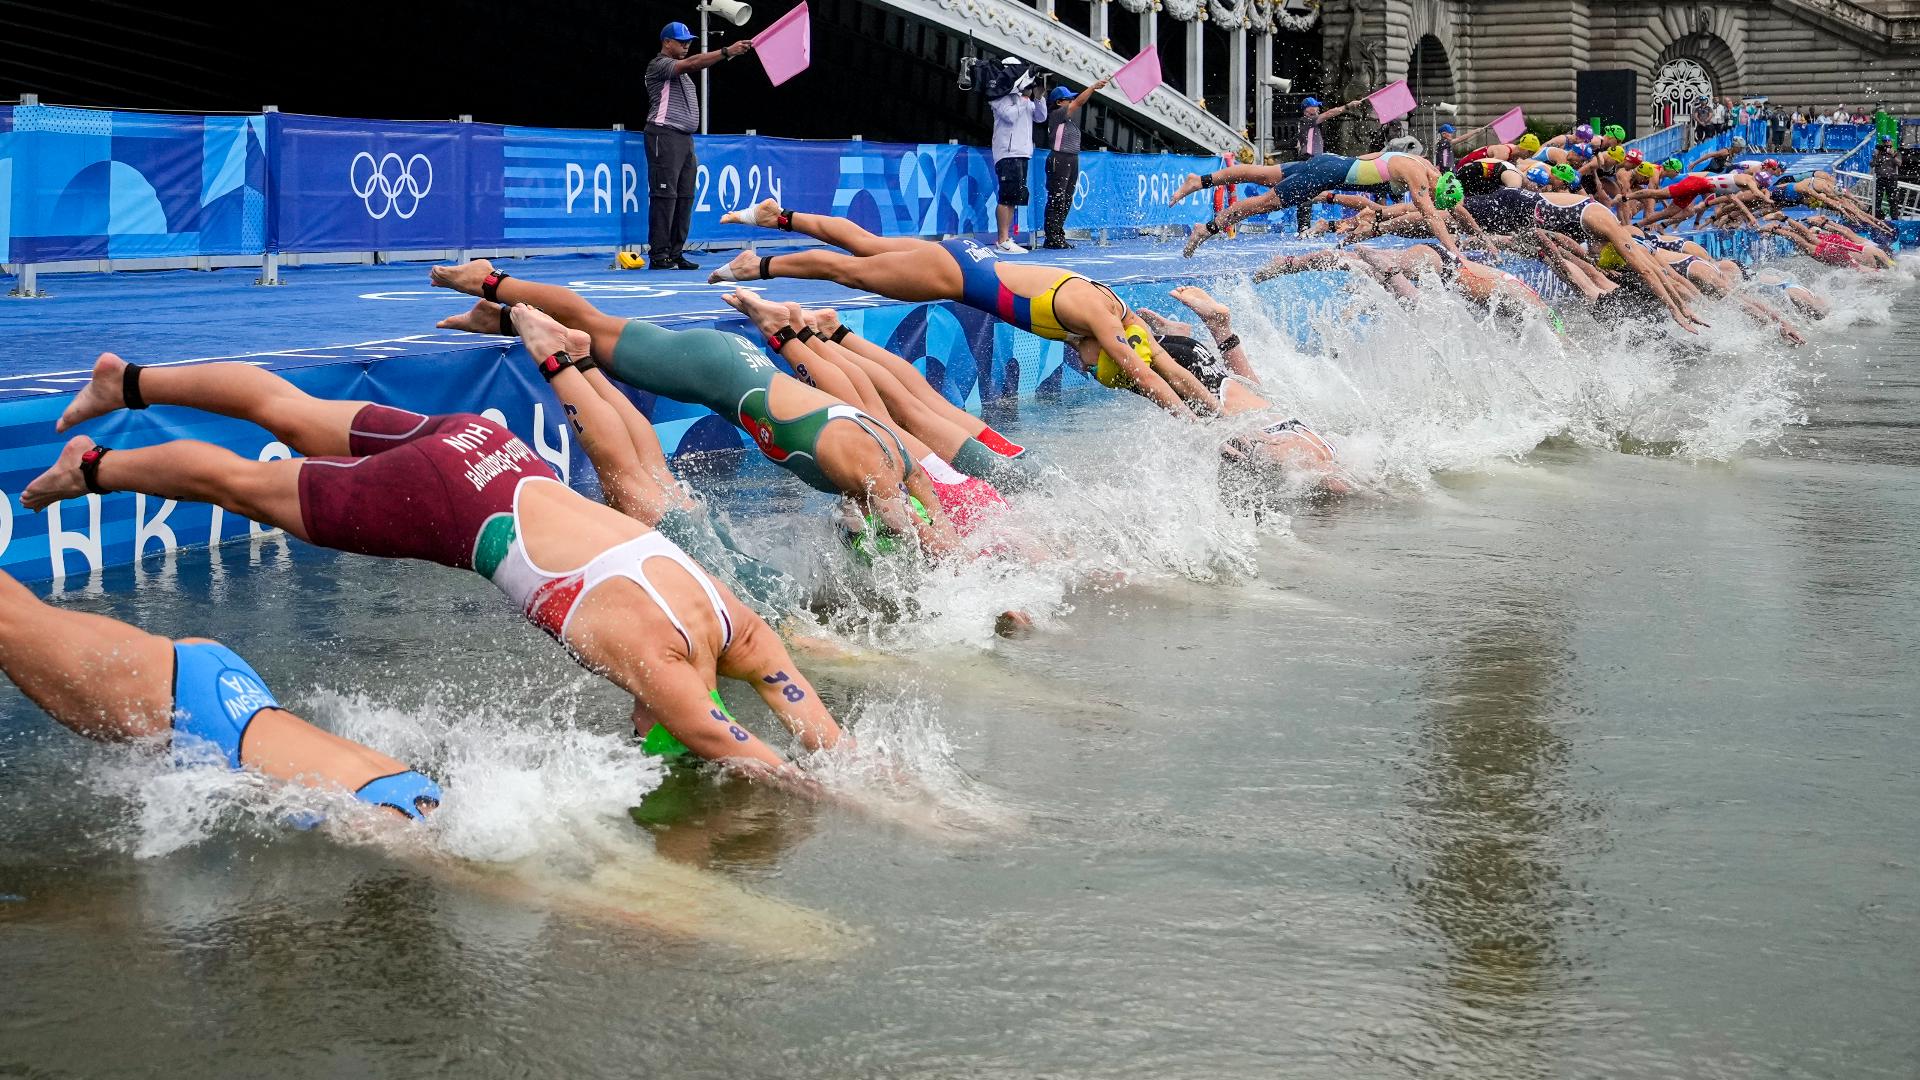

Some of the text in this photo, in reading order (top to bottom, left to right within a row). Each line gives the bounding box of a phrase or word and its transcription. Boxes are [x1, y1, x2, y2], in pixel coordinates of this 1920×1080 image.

[566, 163, 782, 214] PAR 2024
[442, 422, 494, 454] HUN
